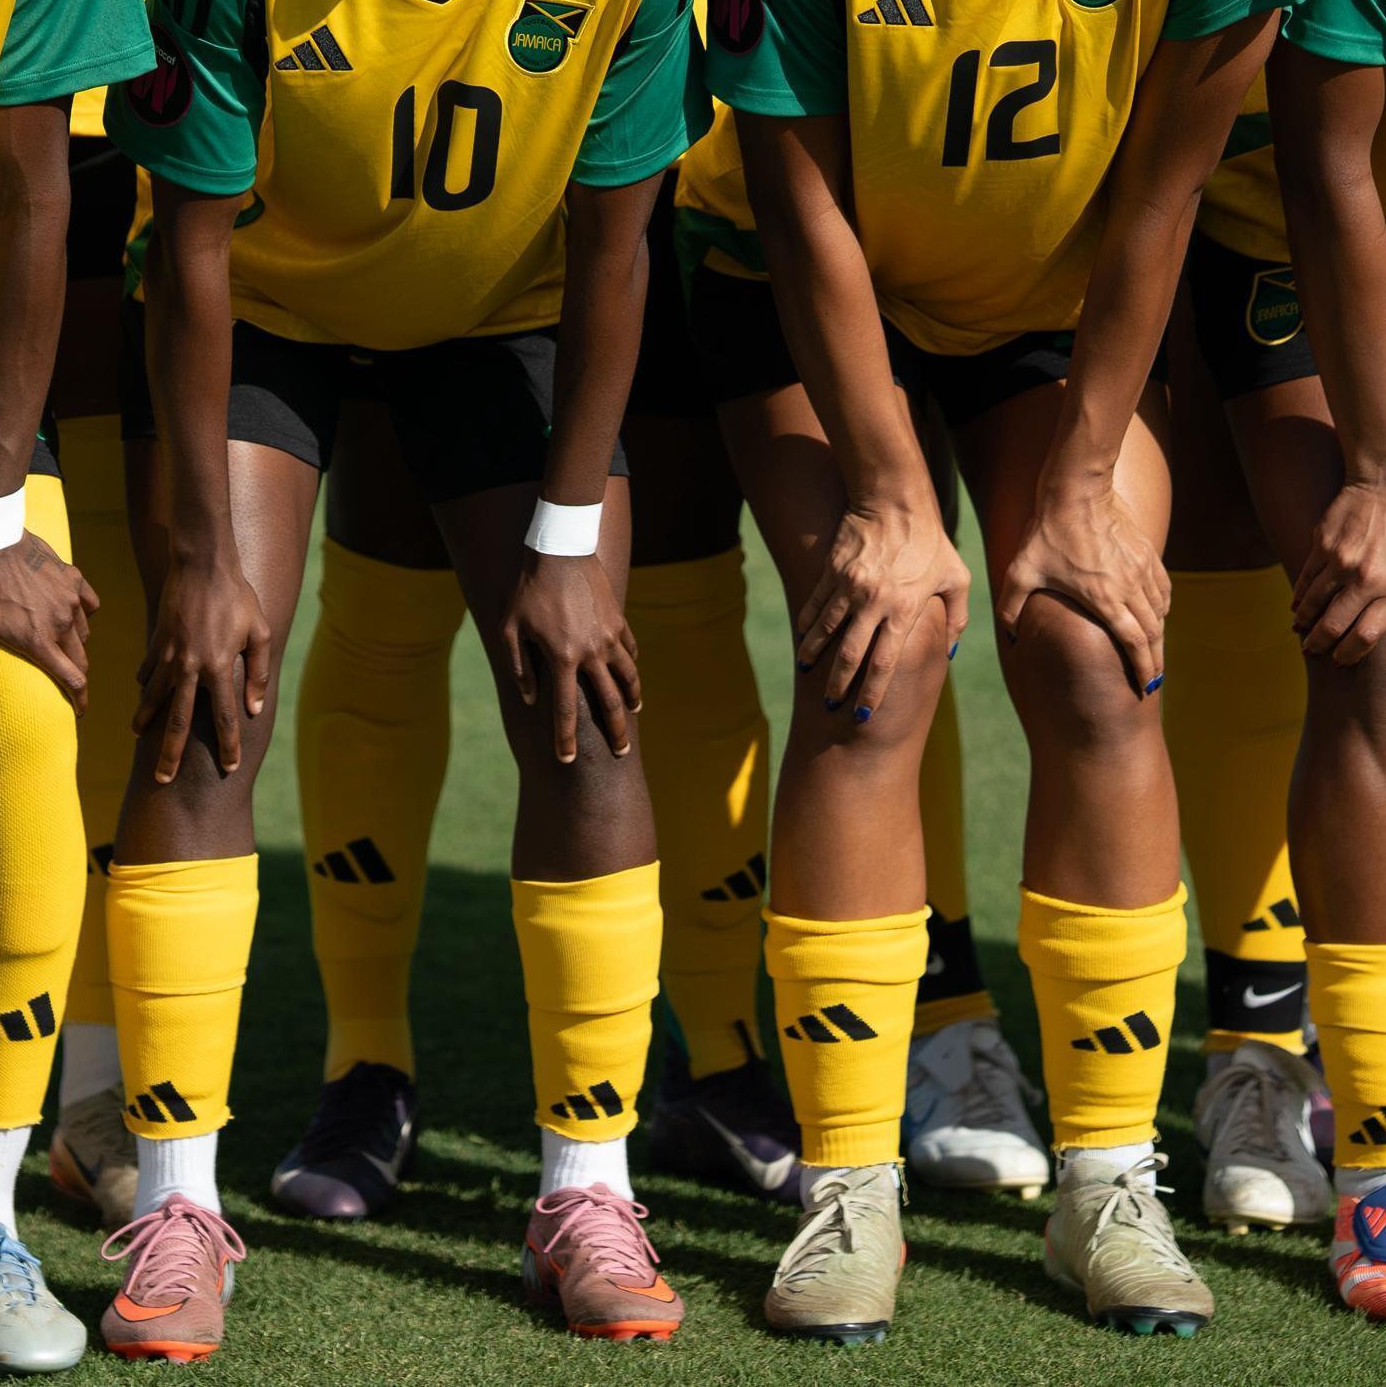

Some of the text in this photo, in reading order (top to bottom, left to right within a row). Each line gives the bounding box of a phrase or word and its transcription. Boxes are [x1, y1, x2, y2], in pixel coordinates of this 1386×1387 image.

[511, 32, 562, 53] JAMAICA
[941, 39, 1061, 167] 12
[389, 79, 503, 212] 10
